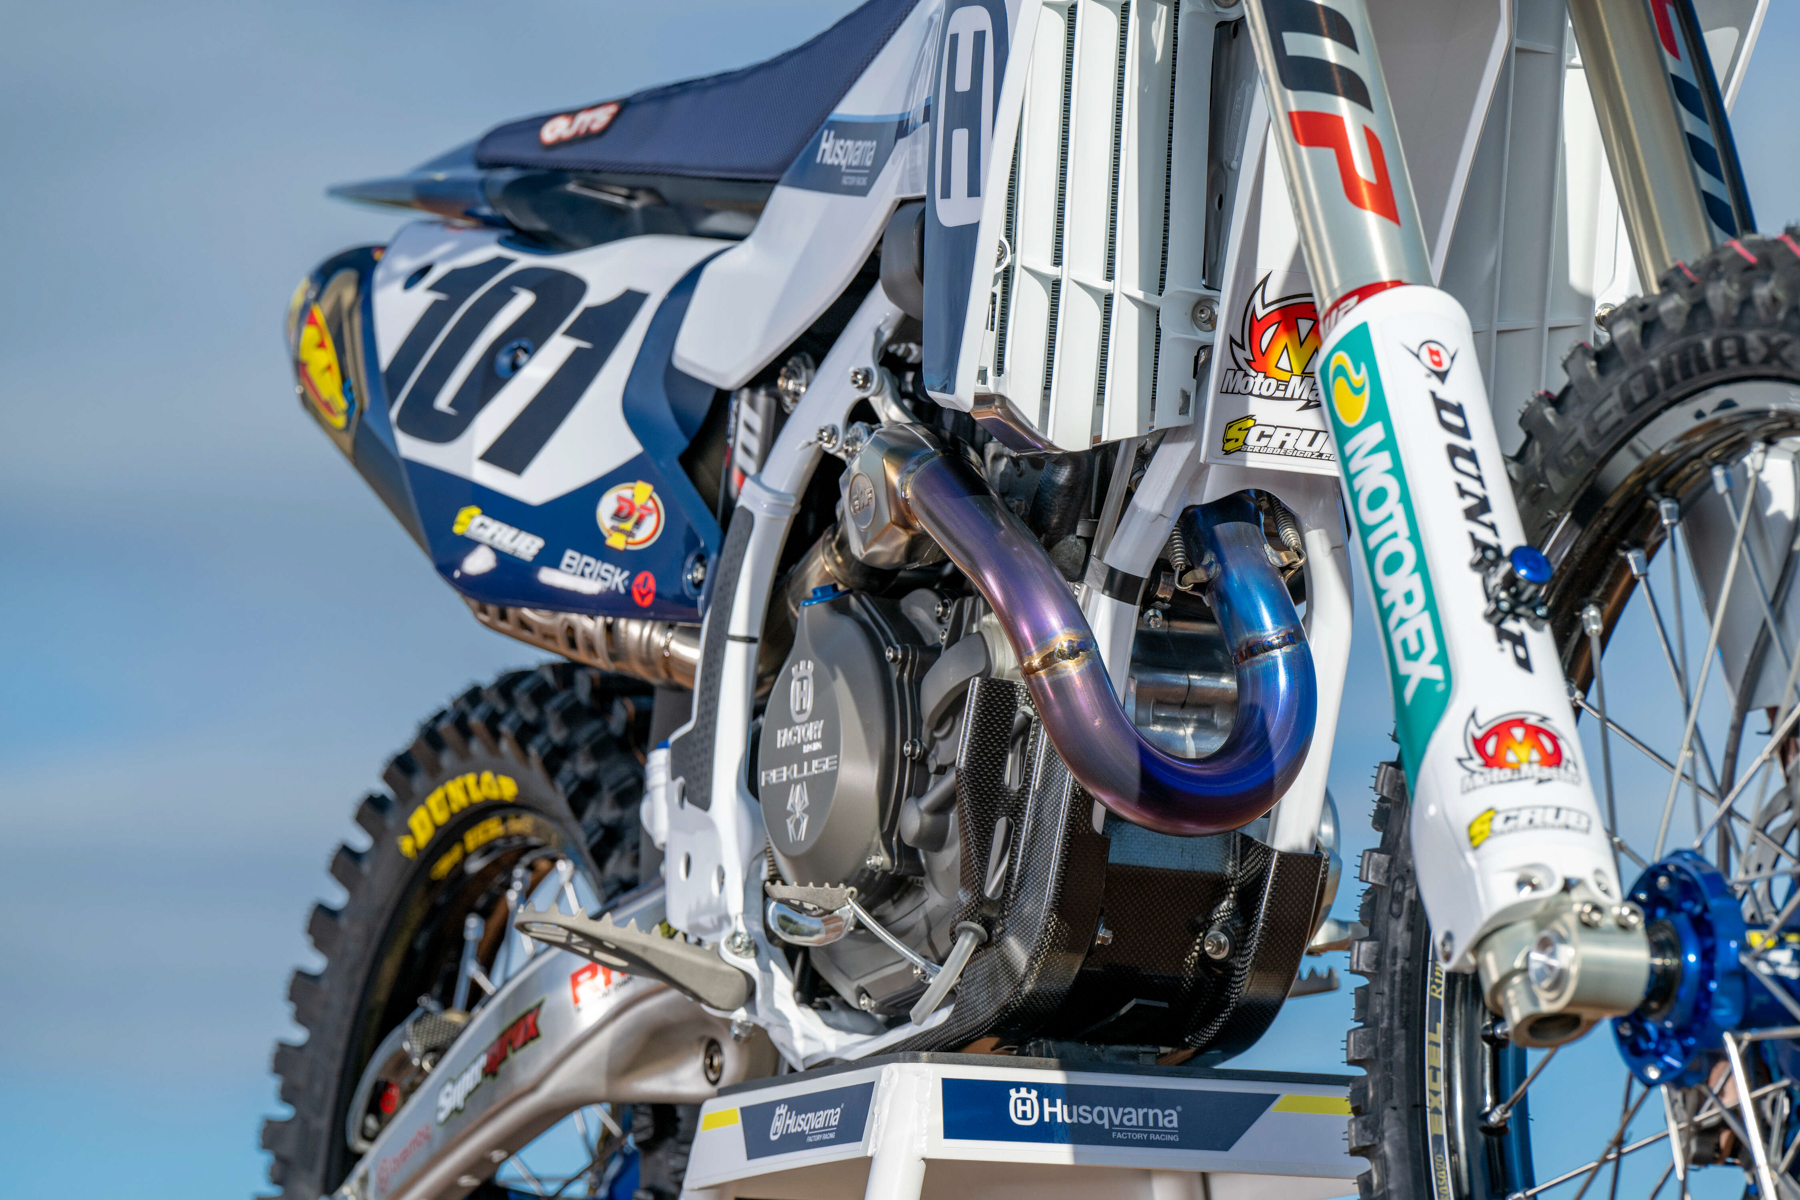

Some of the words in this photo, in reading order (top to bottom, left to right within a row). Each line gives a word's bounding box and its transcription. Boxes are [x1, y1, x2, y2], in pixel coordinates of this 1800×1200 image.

[815, 129, 877, 173] Husqvarna
[383, 256, 650, 477] 101
[1220, 369, 1321, 402] Moto-Ma
[1222, 414, 1331, 455] SCRU
[1241, 444, 1336, 462] SCRUBDESIGNZ.CO
[453, 505, 545, 555] SCRUB
[1429, 389, 1534, 674] DUNP
[559, 548, 631, 594] BRISK
[1344, 421, 1444, 706] MOTOREX
[776, 719, 824, 749] FACTORY
[761, 755, 837, 787] REKLUSE
[1468, 807, 1592, 848] SCRUB
[1427, 1022, 1444, 1138] EXCEL
[782, 1107, 841, 1135] Husqvarna
[1043, 1098, 1179, 1130] Husqvarna
[1112, 1132, 1148, 1141] FACTORY
[1150, 1133, 1179, 1142] RACING
[1434, 1154, 1450, 1200] asago
